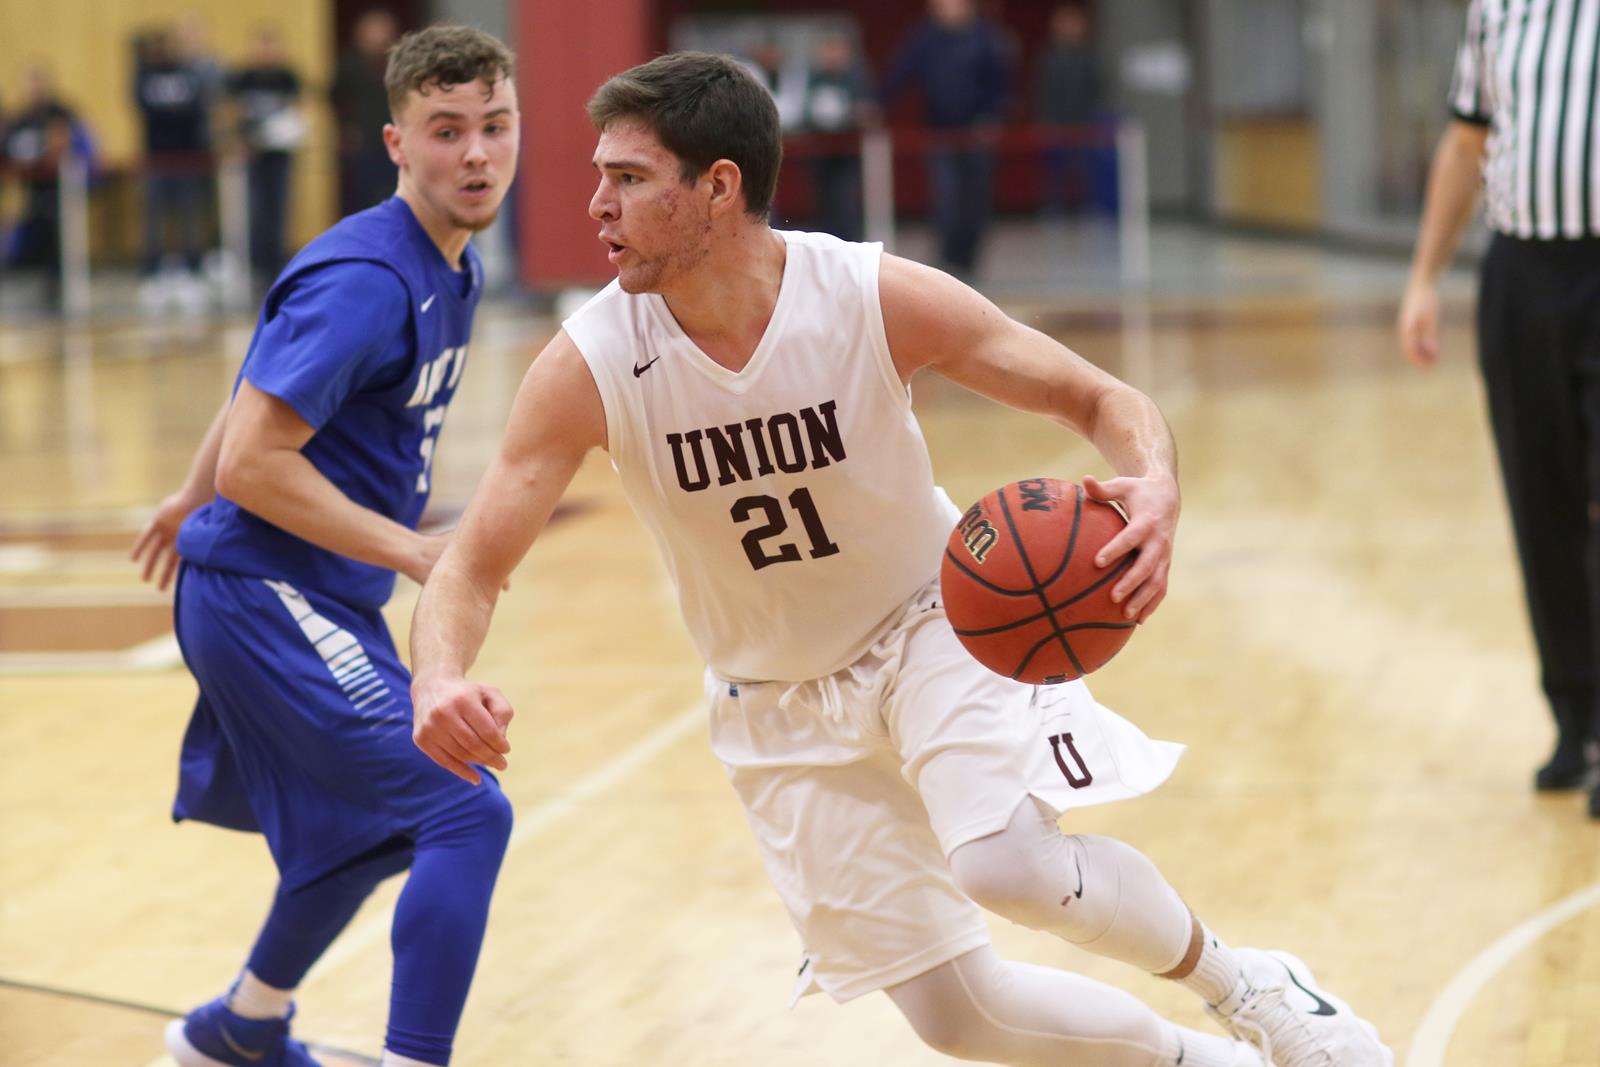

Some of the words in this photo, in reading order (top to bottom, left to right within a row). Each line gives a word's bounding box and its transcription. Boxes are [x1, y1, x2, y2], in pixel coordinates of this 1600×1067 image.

[666, 400, 847, 492] UNION
[730, 487, 840, 571] 21
[1048, 732, 1093, 789] U
